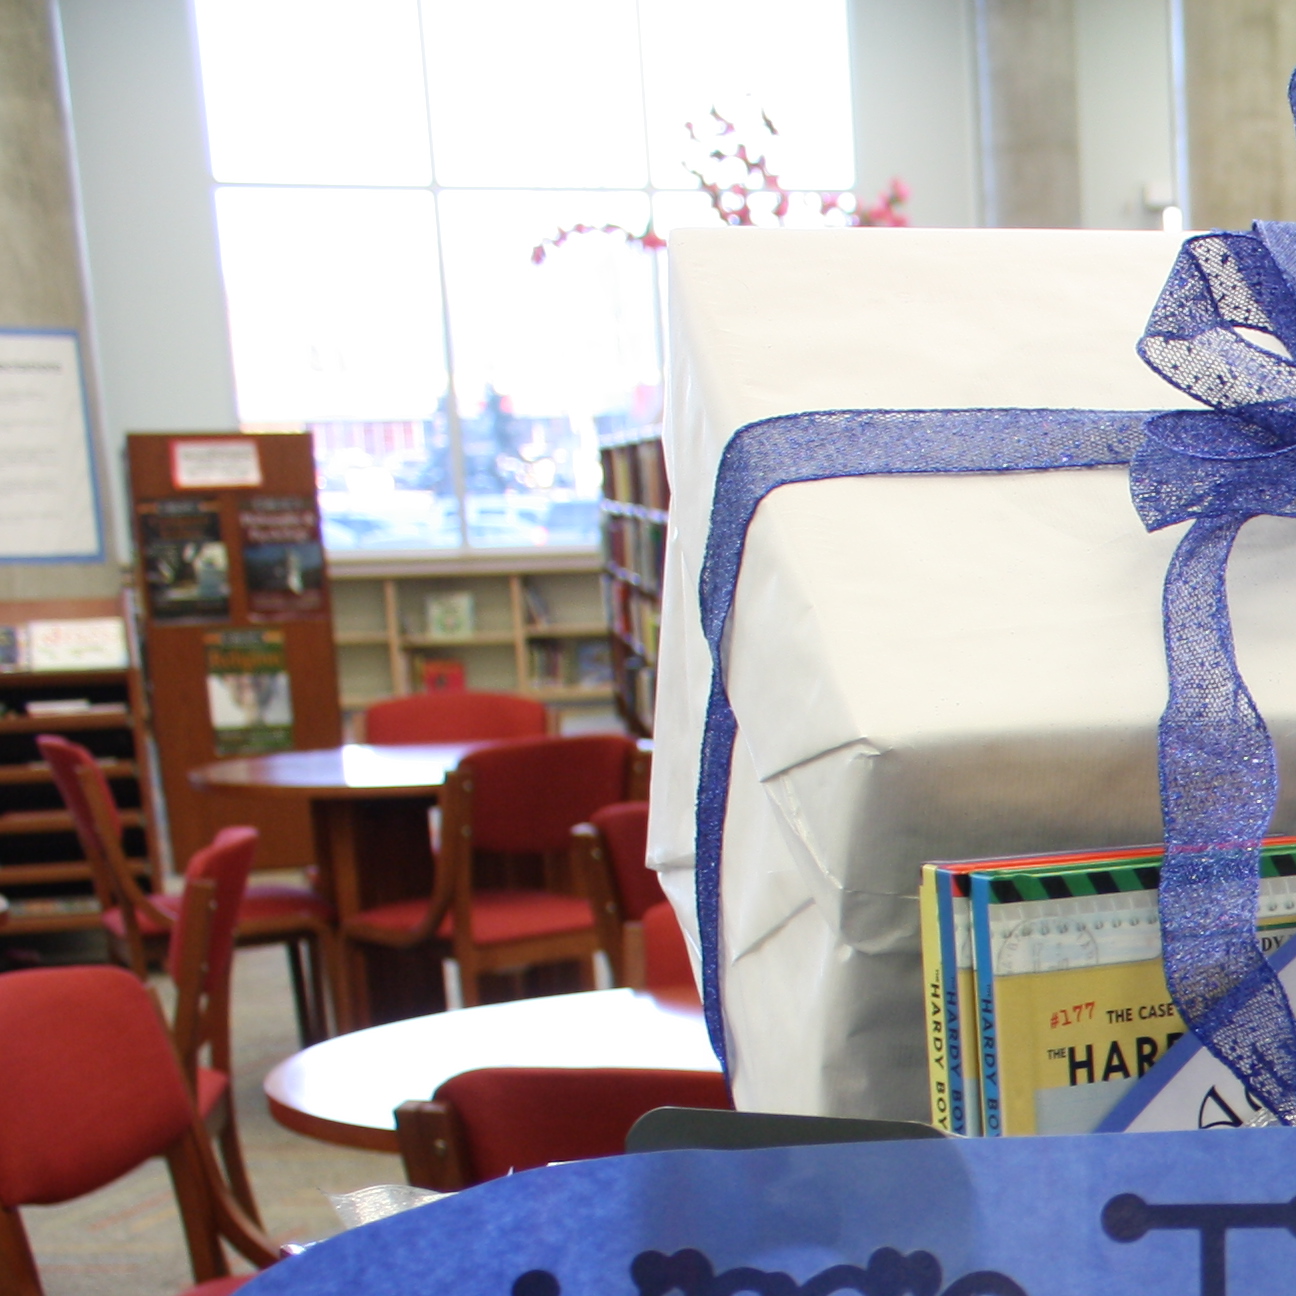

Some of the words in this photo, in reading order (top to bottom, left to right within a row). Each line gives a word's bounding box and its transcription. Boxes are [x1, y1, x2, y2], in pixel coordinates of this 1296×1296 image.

[930, 984, 944, 1070] HARDY
[946, 991, 961, 1077] HARDY
[1050, 1001, 1096, 1029] #177
[1107, 1009, 1133, 1024] THE
[982, 999, 997, 1086] HARDY
[1047, 1047, 1067, 1060] THE
[1068, 1032, 1184, 1086] HAR
[936, 1081, 948, 1130] BOY
[952, 1089, 965, 1136] BOY
[987, 1099, 1000, 1133] BO
